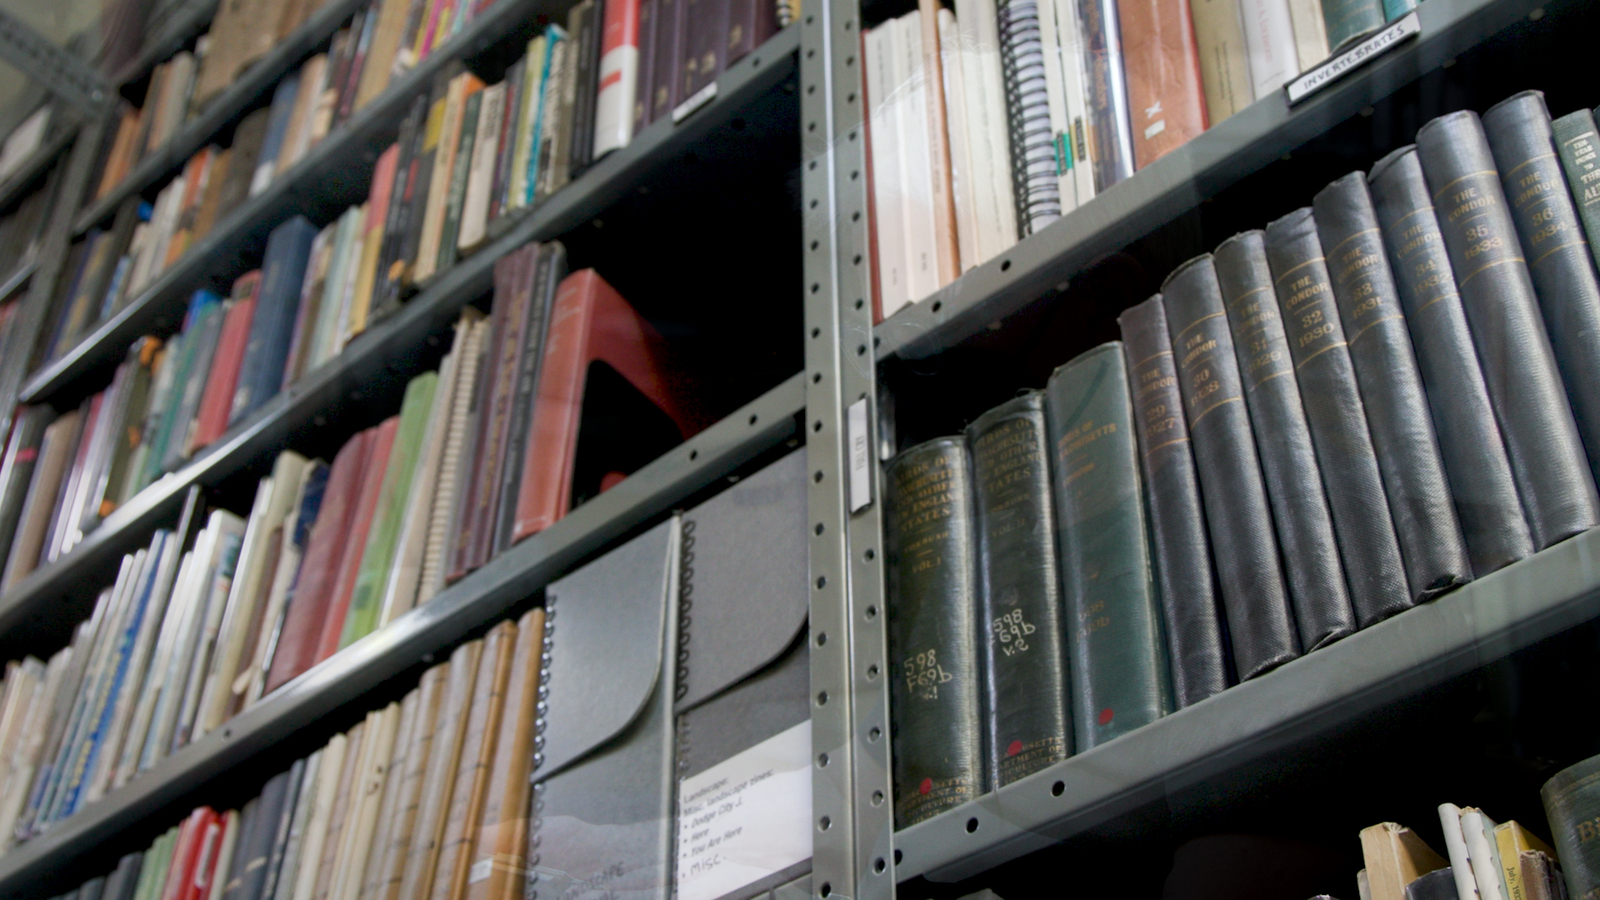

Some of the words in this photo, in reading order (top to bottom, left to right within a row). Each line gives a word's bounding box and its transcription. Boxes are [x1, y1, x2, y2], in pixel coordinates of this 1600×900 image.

[1303, 25, 1406, 90] INVERTEBRATES
[1520, 171, 1541, 188] THE
[1453, 187, 1477, 204] THE
[1515, 179, 1560, 208] CONDOR
[1449, 195, 1496, 222] CONDOR
[1532, 207, 1554, 226] 36
[1403, 223, 1424, 241] THE
[1466, 224, 1489, 242] 35
[1531, 220, 1568, 246] 1934
[1343, 247, 1364, 264] THE
[1465, 236, 1504, 260] 1933
[1415, 259, 1436, 277] 34
[1291, 275, 1312, 293] THE
[1353, 282, 1373, 302] 33
[1285, 281, 1329, 311] CONDOR
[1353, 296, 1383, 319] 1931
[1240, 302, 1262, 319] THE
[1302, 310, 1324, 329] 32
[1185, 332, 1204, 351] THE
[1299, 322, 1335, 349] 1930
[1182, 339, 1218, 370] CONDOR
[1141, 367, 1162, 384] THE
[1193, 368, 1210, 388] 30
[986, 467, 1032, 493] TATES
[912, 492, 963, 515] ENGLAN
[992, 609, 1022, 632] 598
[904, 649, 936, 676] 598
[907, 664, 953, 693] F69b
[706, 781, 747, 807] landscape
[691, 811, 716, 829] Dodge
[718, 802, 734, 815] City
[691, 828, 709, 843] Here
[691, 844, 706, 857] You
[707, 836, 722, 849] Are
[723, 826, 742, 842] Here
[1512, 885, 1522, 900] 193
